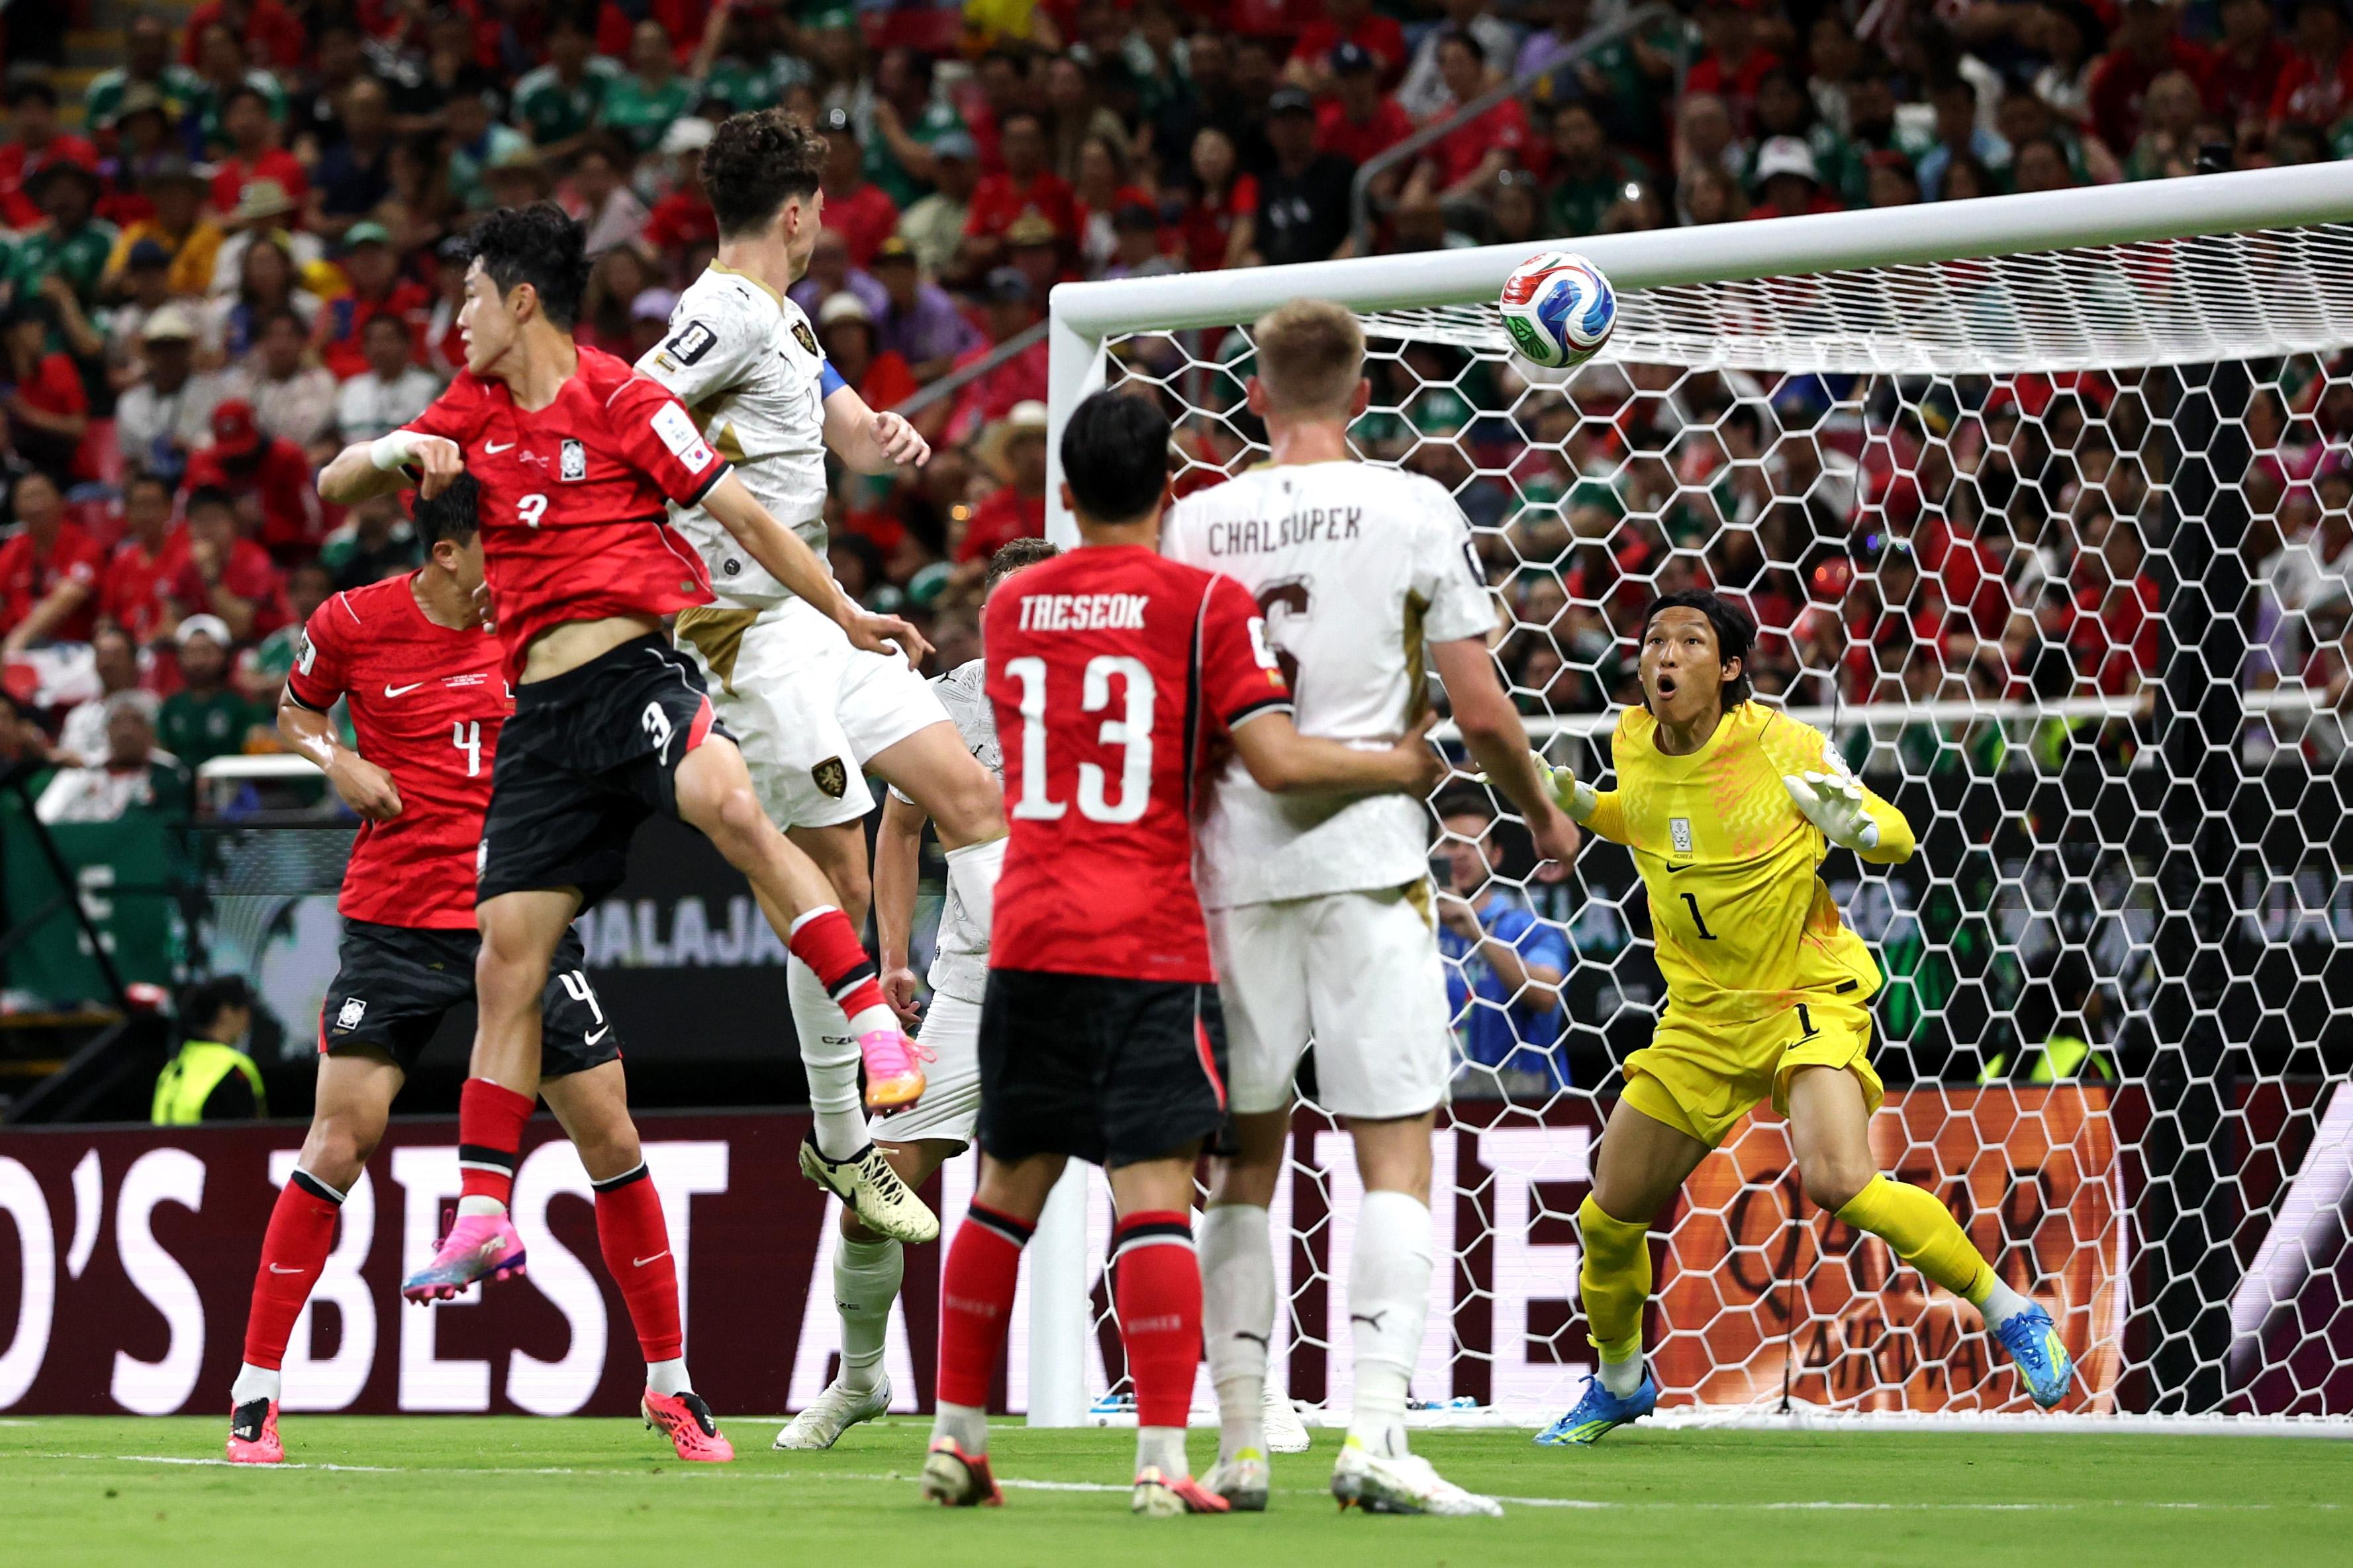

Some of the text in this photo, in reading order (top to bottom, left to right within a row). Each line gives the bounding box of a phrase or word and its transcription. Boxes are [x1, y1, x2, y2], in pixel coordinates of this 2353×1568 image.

[1020, 593, 1149, 631] TAESEOK
[454, 721, 481, 777] 4
[642, 701, 671, 749] 3
[1004, 655, 1155, 823] 13
[1680, 892, 1717, 940] 1
[557, 970, 603, 1025] 4
[1794, 1003, 1820, 1040] 1
[269, 1140, 729, 1416] BEST
[1794, 1316, 2013, 1390] AIRWA
